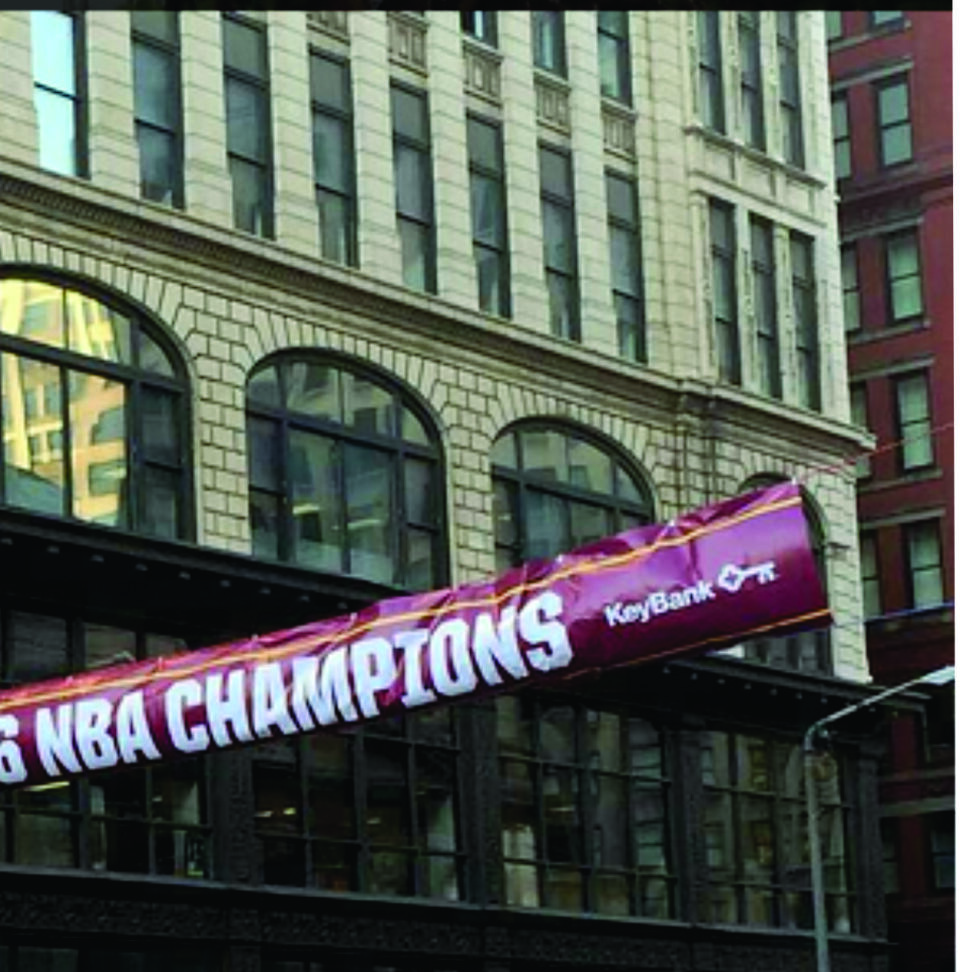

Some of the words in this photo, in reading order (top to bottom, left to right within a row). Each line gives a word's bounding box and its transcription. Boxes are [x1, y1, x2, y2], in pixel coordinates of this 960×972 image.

[603, 579, 716, 627] KeyBank
[37, 693, 161, 777] NBA
[166, 591, 574, 753] CHAMPIONS
